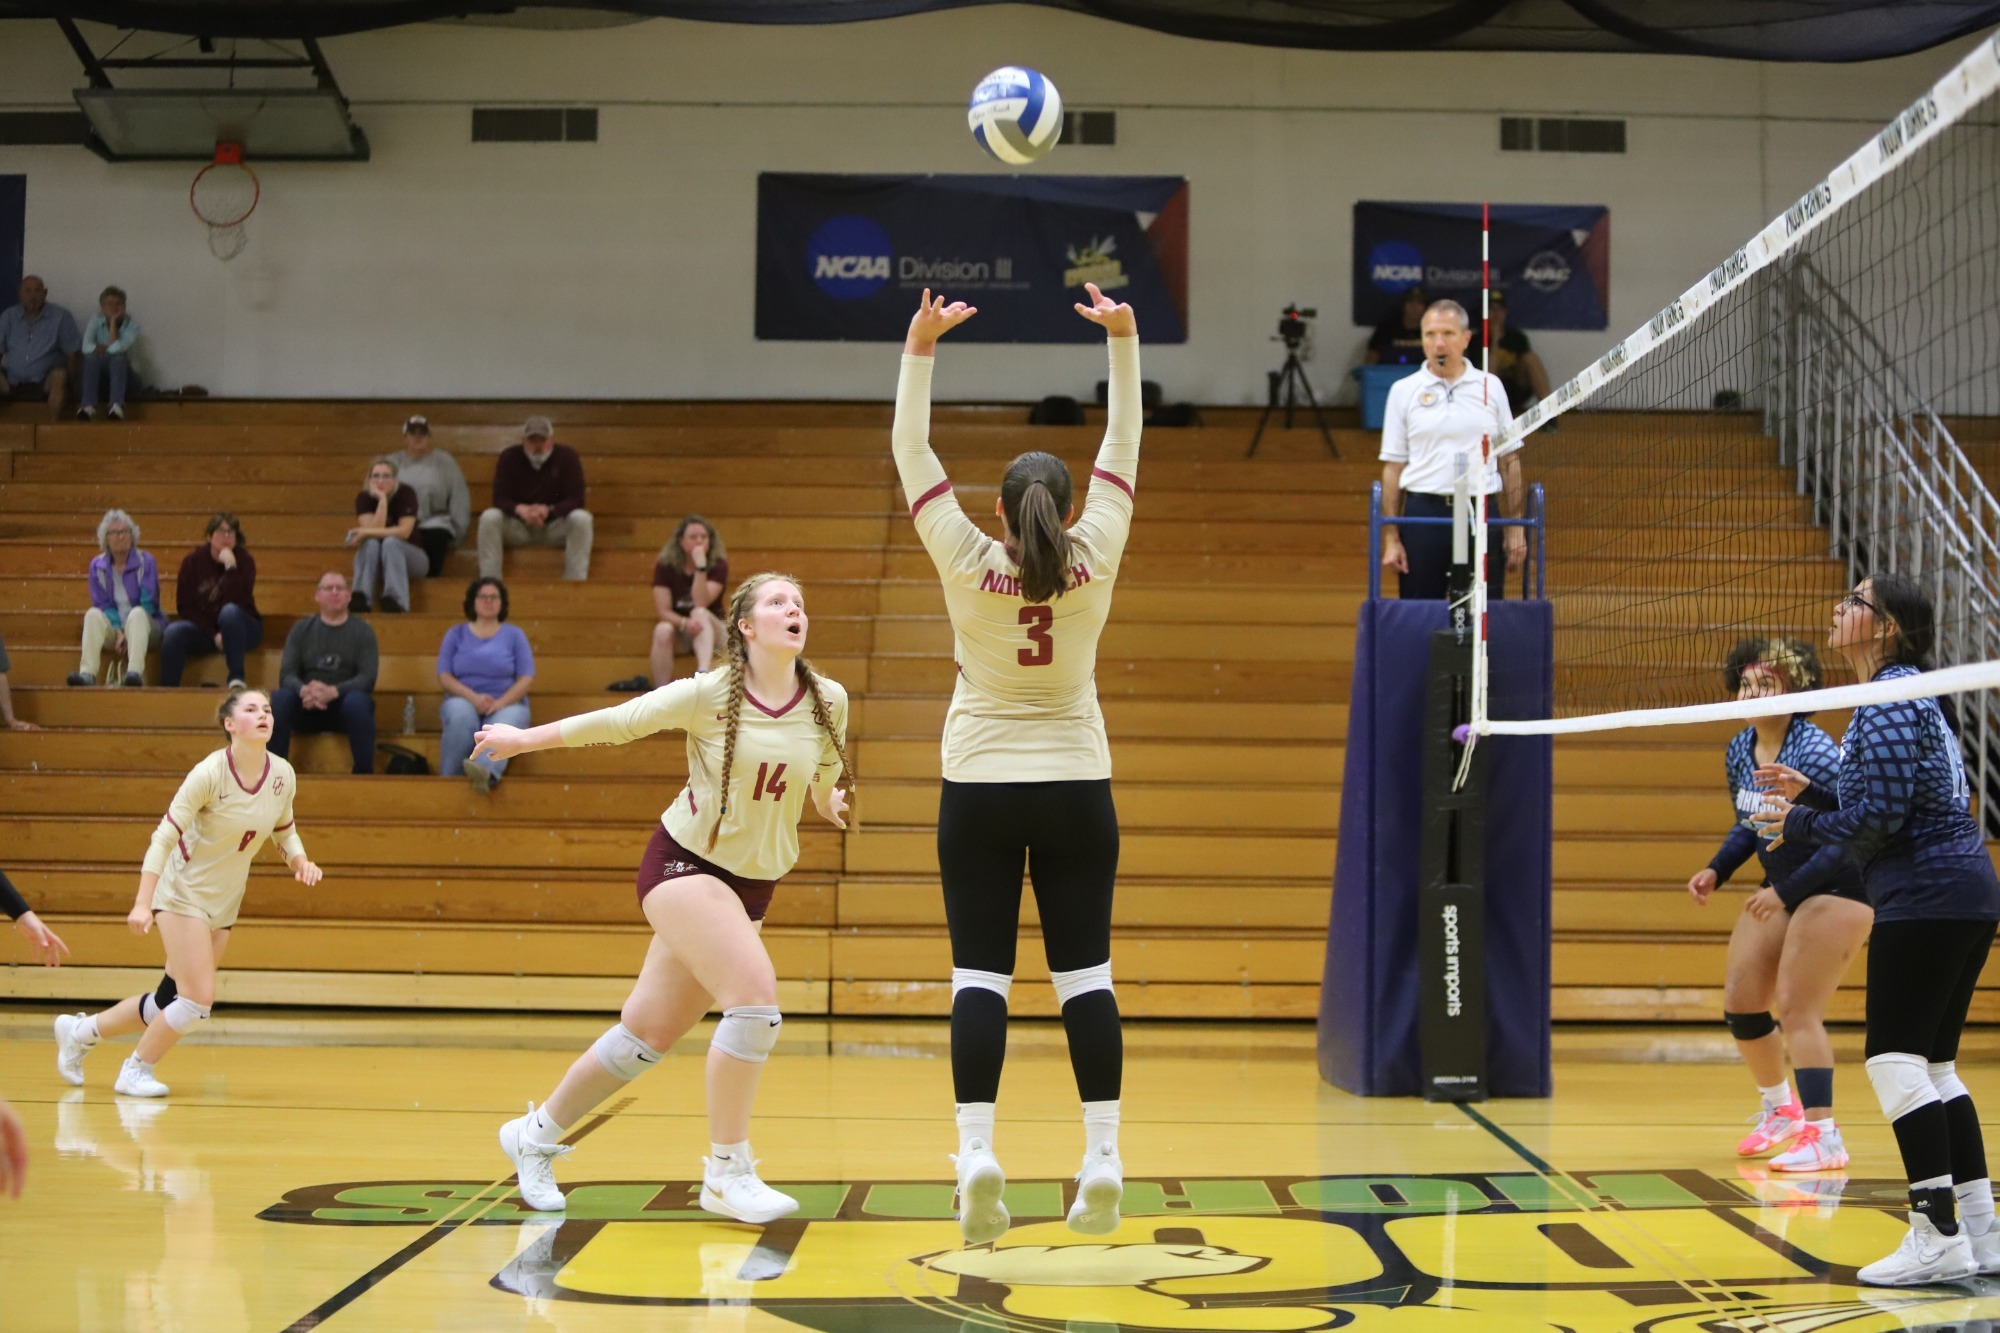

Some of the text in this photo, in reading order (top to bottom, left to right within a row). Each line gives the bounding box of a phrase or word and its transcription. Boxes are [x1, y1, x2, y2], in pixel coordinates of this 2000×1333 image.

[814, 255, 890, 279] NCAA
[899, 256, 1013, 280] Division III
[1372, 265, 1423, 281] NCAA
[1017, 605, 1054, 667] 3
[752, 762, 788, 802] 14
[1441, 904, 1463, 1017] sports imports
